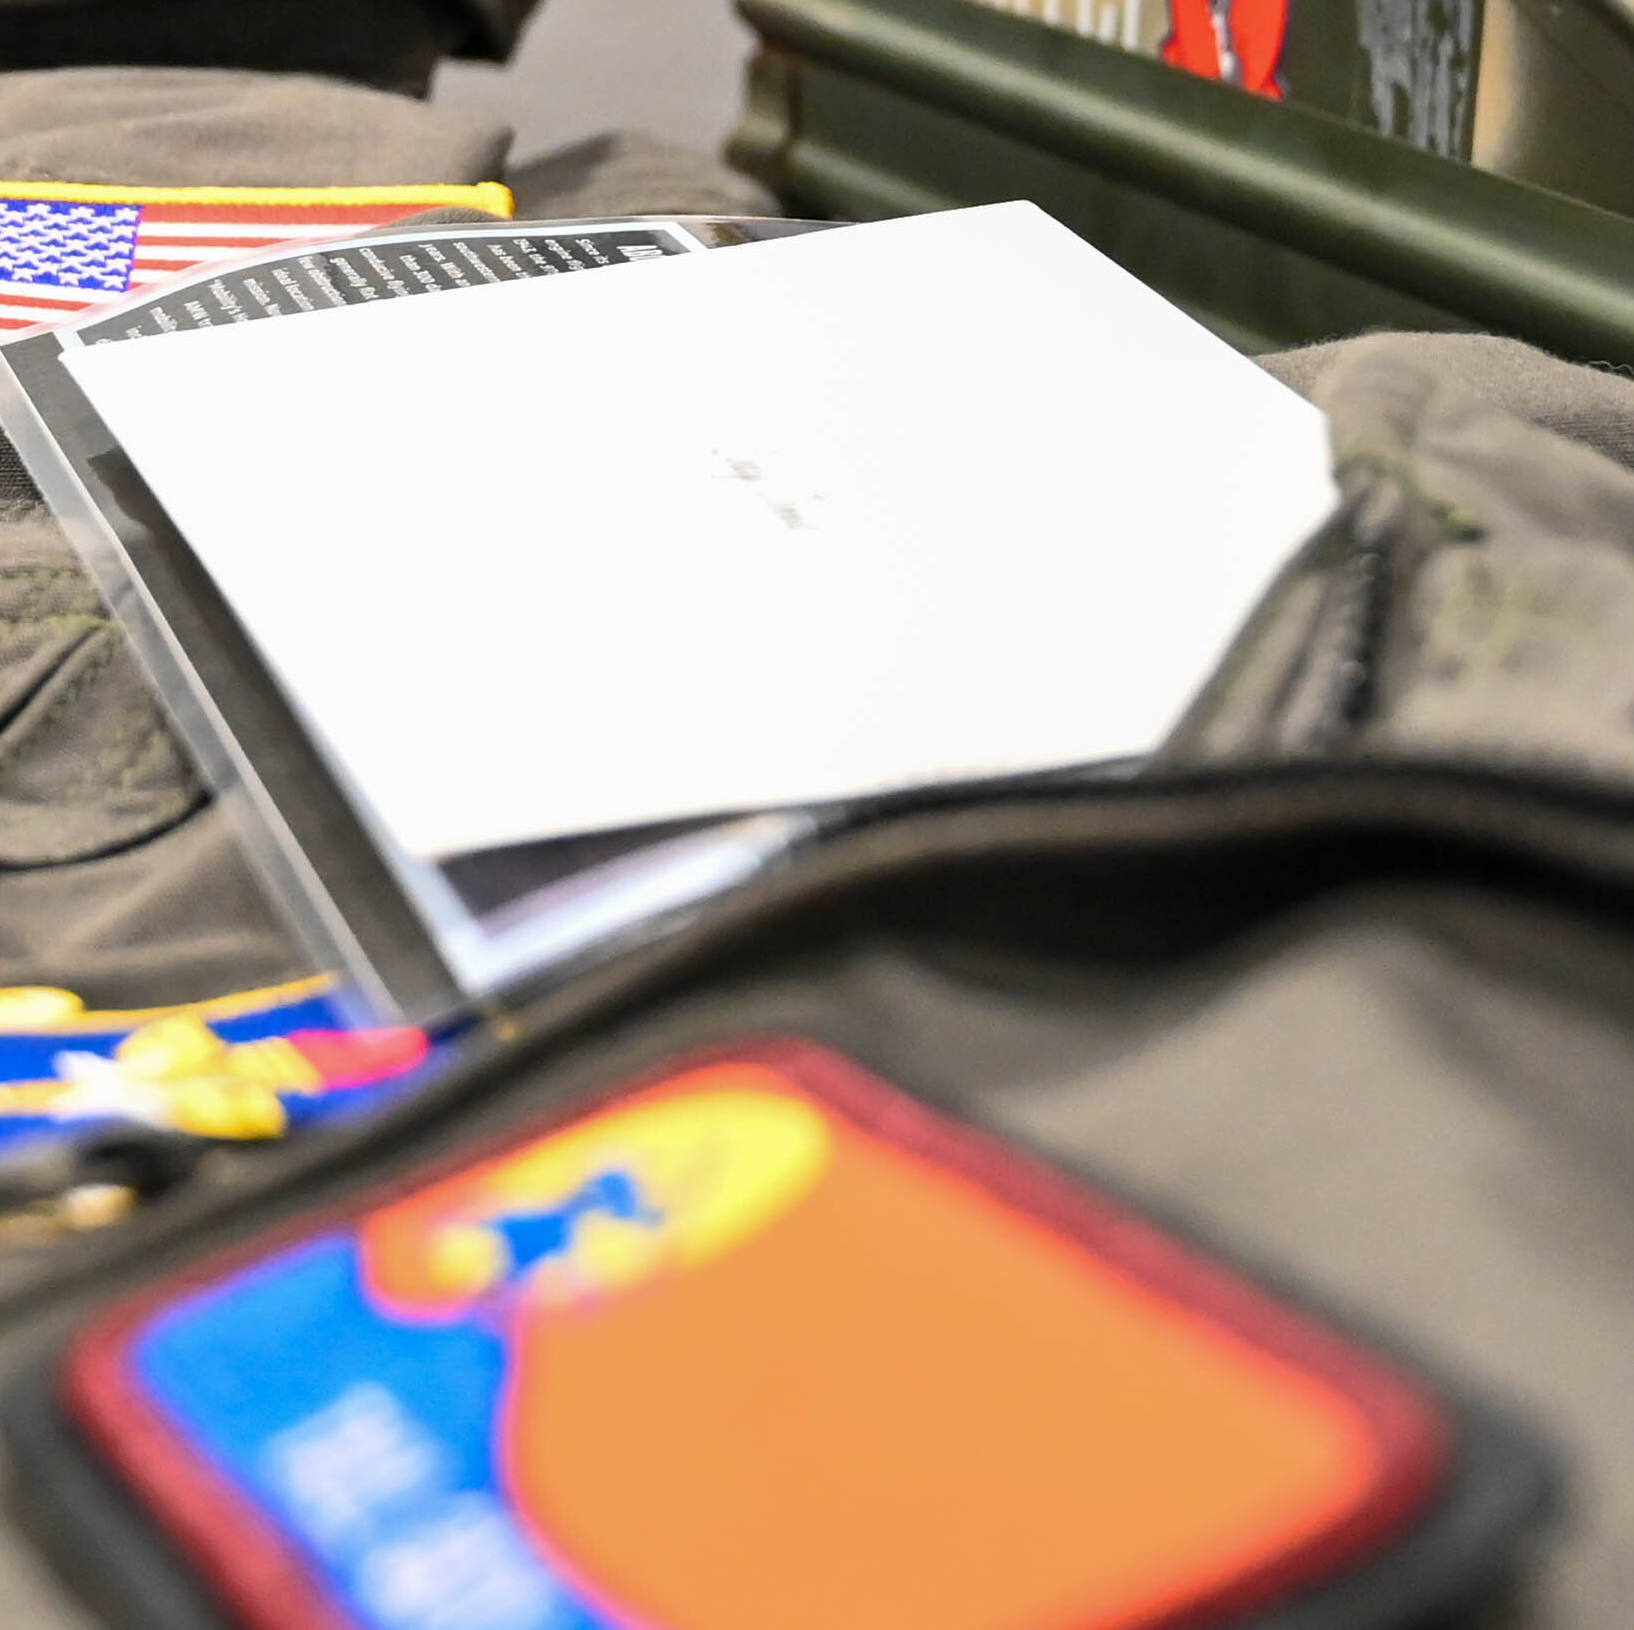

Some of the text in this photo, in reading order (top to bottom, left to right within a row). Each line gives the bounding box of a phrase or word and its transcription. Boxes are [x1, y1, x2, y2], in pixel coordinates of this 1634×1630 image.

[487, 244, 507, 256] has
[499, 255, 522, 272] been
[575, 238, 600, 256] Since
[329, 257, 367, 287] generally
[359, 247, 395, 281] conducive
[399, 254, 421, 271] than
[271, 267, 298, 286] ideal
